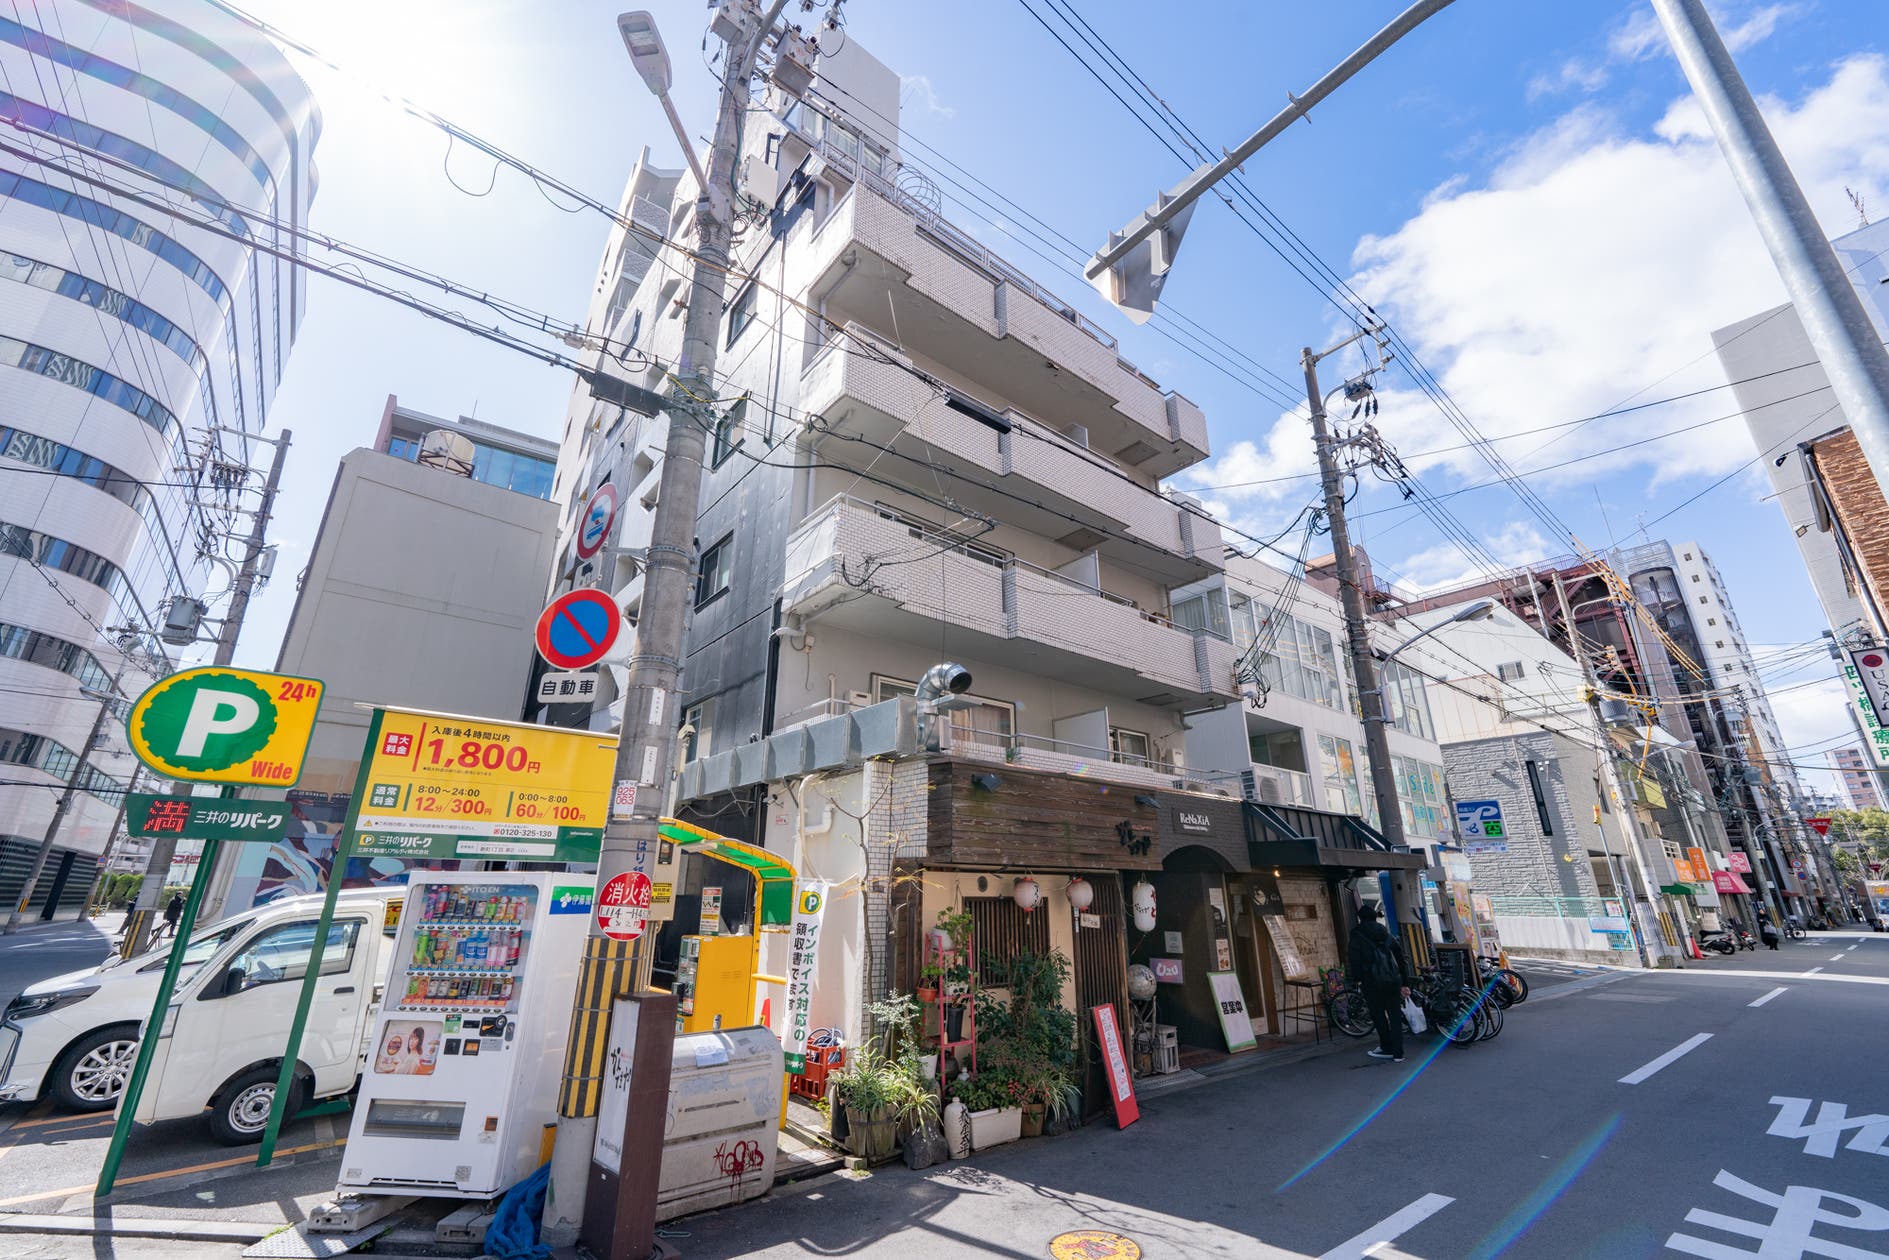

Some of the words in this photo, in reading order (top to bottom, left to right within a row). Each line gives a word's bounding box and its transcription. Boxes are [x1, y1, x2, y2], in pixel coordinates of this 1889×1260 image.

[278, 681, 317, 702] 24h
[541, 679, 595, 695] 自動車
[175, 688, 259, 757] P
[388, 734, 410, 745] 最大
[431, 725, 511, 742] 入庫後4時間以内
[386, 744, 407, 755] 料金
[427, 738, 541, 774] 1,800円
[251, 760, 293, 780] Wide
[375, 785, 397, 796] 通常
[373, 795, 395, 806] 料金
[143, 800, 189, 832] 満
[193, 811, 282, 829] 三井のリパーク
[378, 836, 432, 847] 三井のリパーク
[500, 828, 552, 838] 0120-325-130
[606, 882, 651, 906] 消火栓
[787, 922, 807, 1011] 領収書でます
[794, 924, 819, 1042] インボイス対応の
